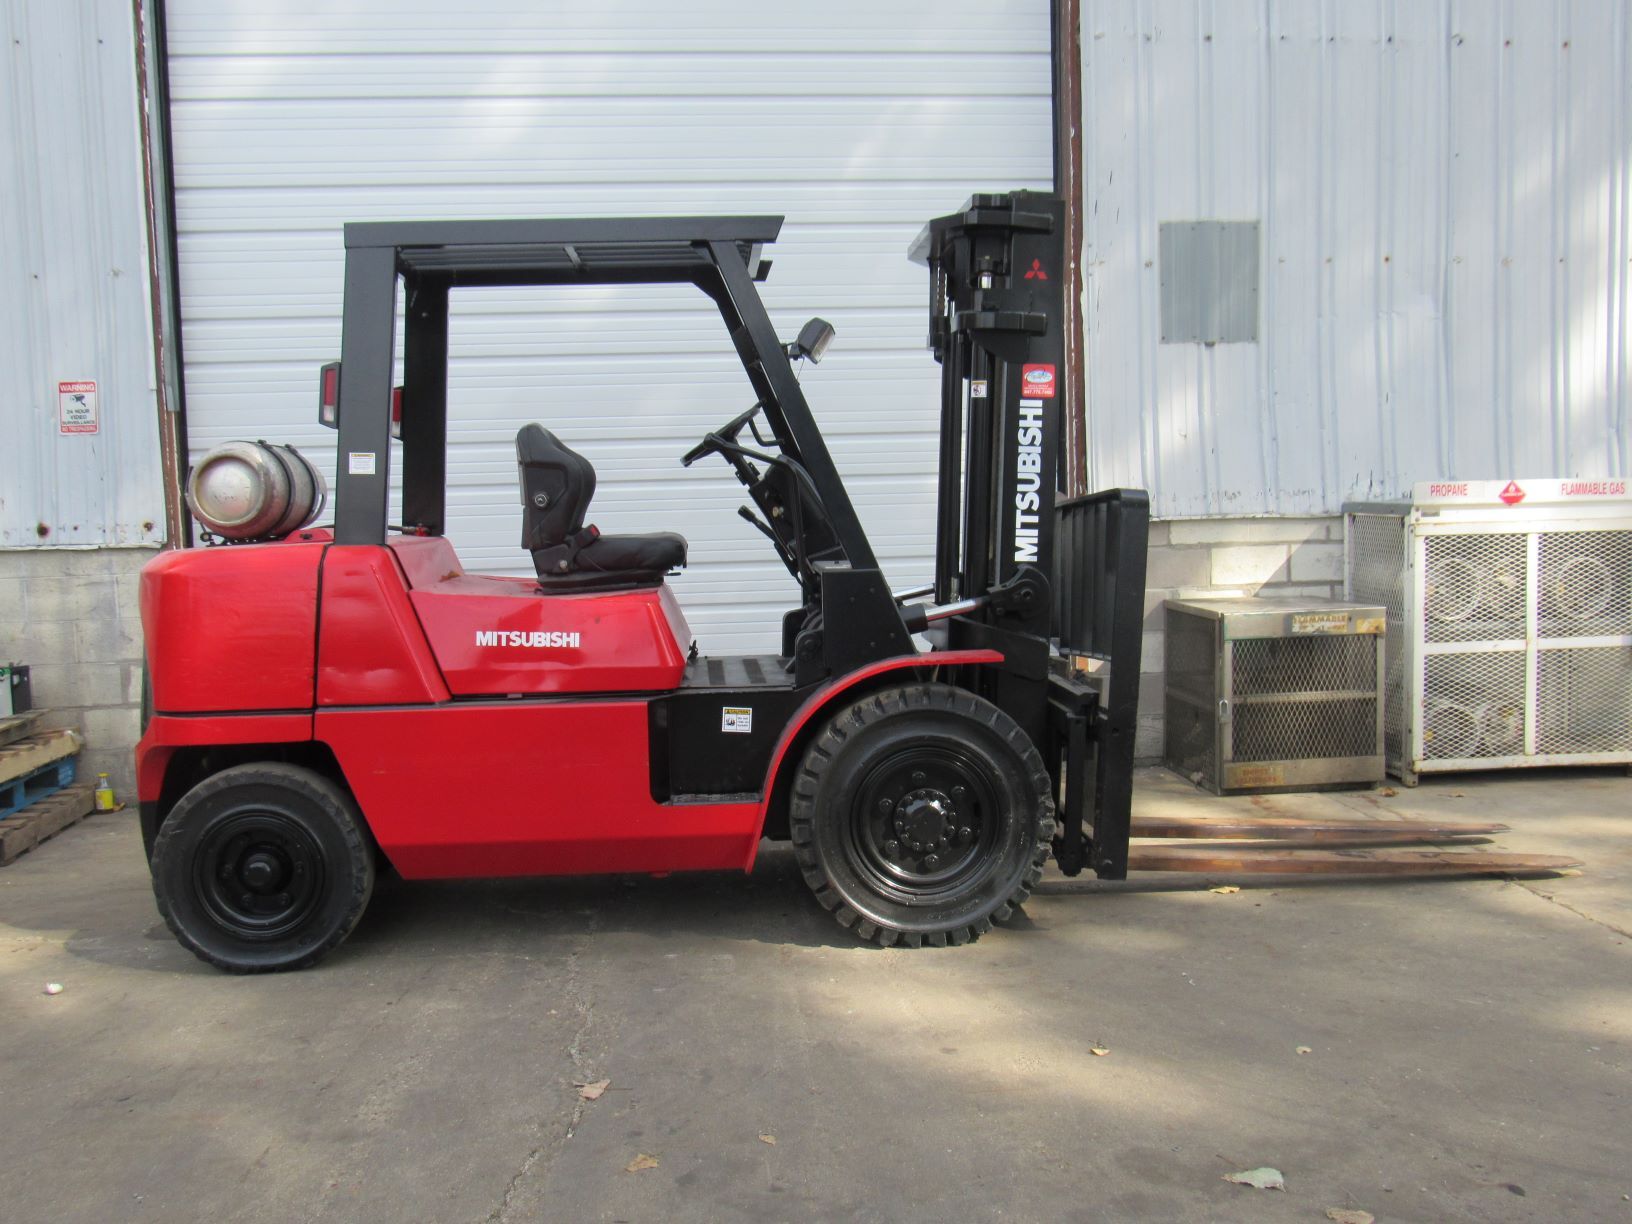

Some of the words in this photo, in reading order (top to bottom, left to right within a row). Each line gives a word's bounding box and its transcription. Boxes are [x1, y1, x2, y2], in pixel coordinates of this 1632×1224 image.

[60, 384, 95, 392] WARNING
[1014, 399, 1043, 563] MITSUBISHI
[1430, 484, 1468, 497] PROPANE
[1561, 483, 1607, 496] FLAMMABLE
[1609, 482, 1626, 495] GAS
[476, 631, 580, 648] MITSUBISHI
